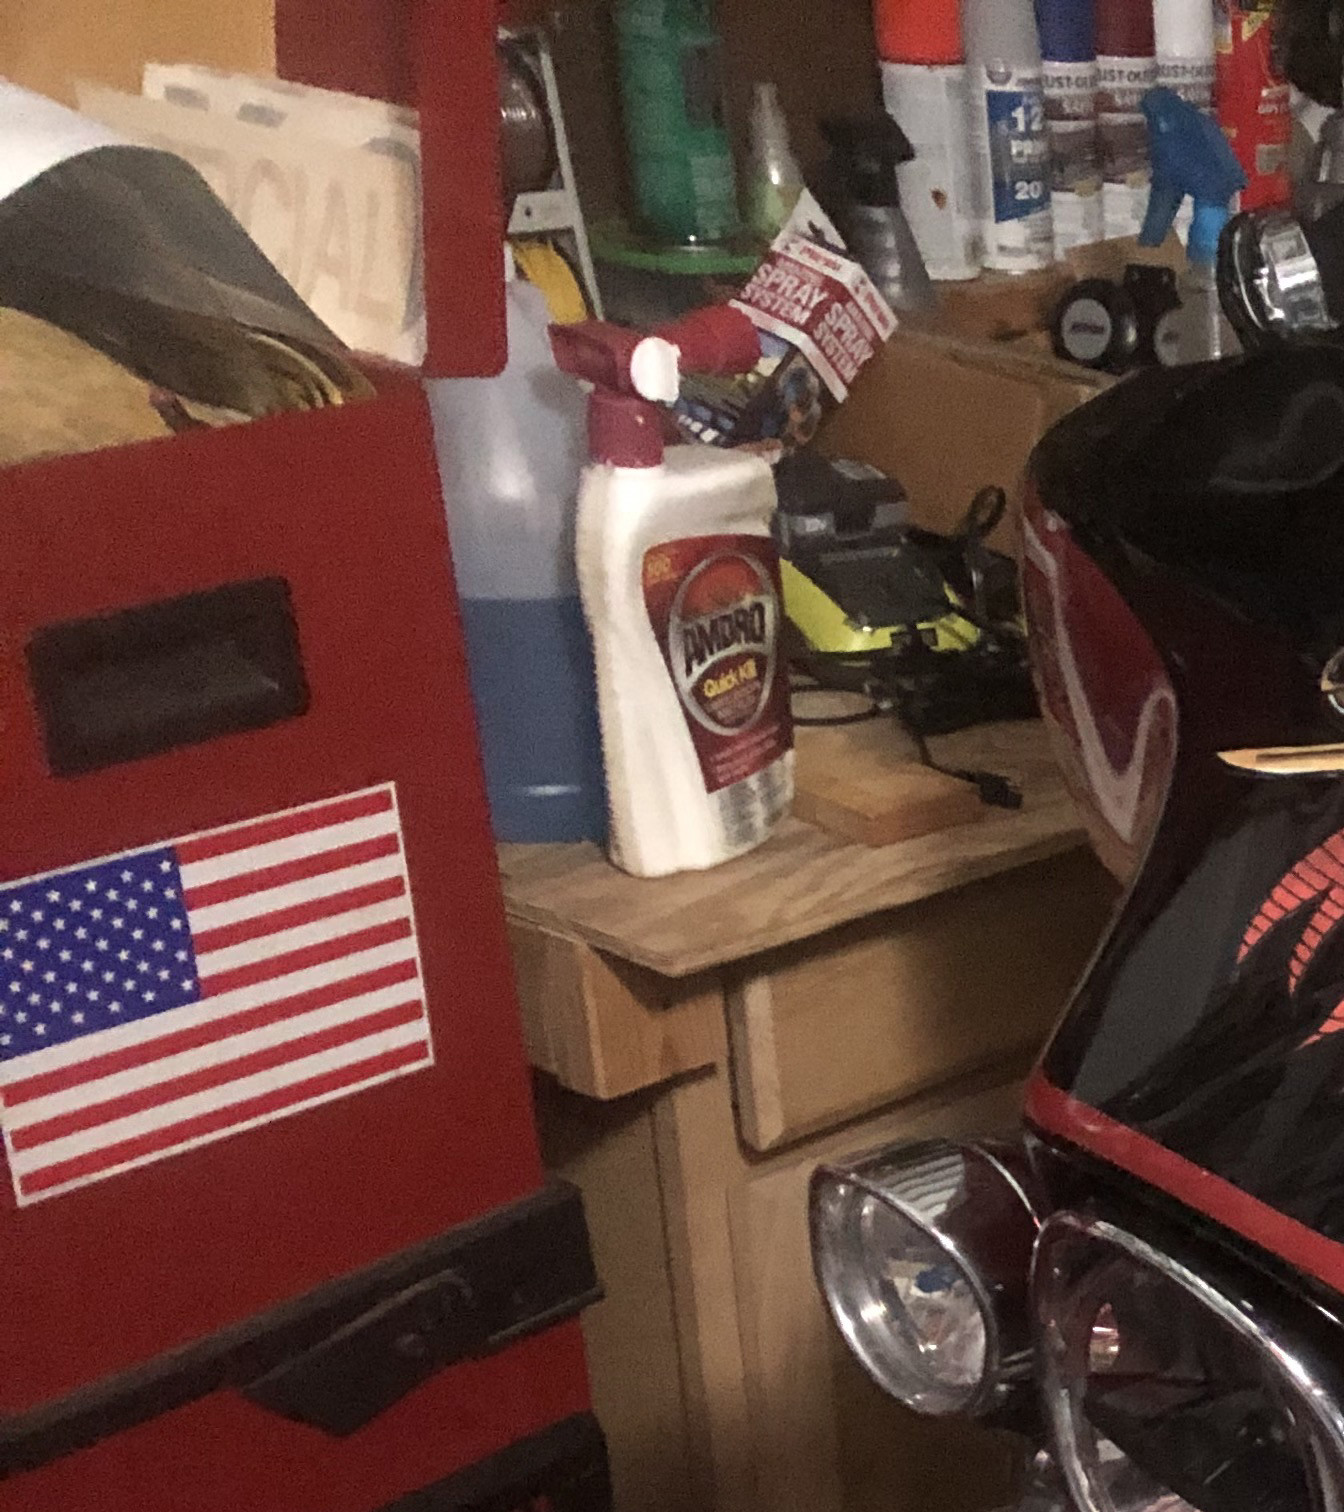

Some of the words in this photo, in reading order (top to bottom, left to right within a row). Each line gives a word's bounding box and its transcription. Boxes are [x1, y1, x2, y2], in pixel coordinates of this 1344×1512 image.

[1013, 179, 1040, 201] 20
[739, 282, 812, 326] SYSTEM
[751, 262, 830, 310] SPRAY
[823, 301, 876, 368] SPRAY
[682, 600, 766, 679] AMDRO
[703, 668, 738, 699] Quick
